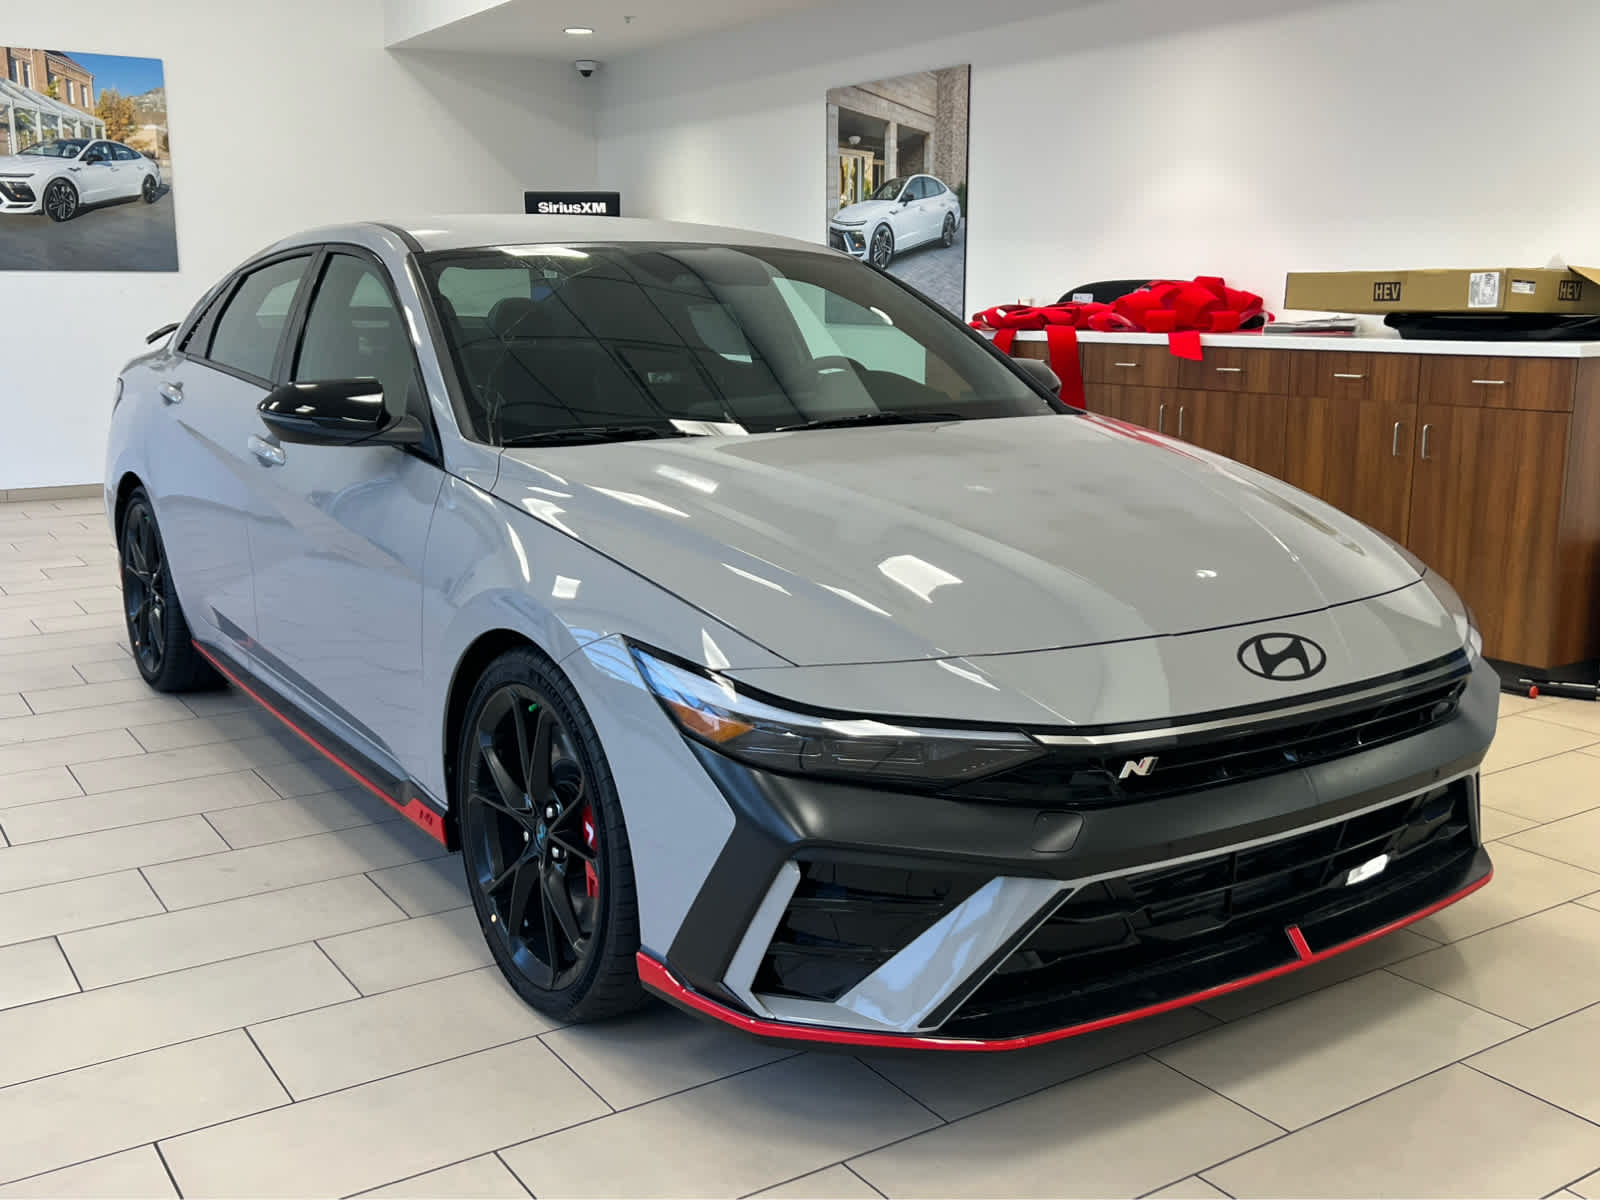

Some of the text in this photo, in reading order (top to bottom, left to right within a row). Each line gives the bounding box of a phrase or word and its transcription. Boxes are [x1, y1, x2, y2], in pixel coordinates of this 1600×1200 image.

[538, 202, 606, 213] SiriusXM
[1375, 283, 1400, 299] HEV
[1560, 281, 1582, 299] HEV
